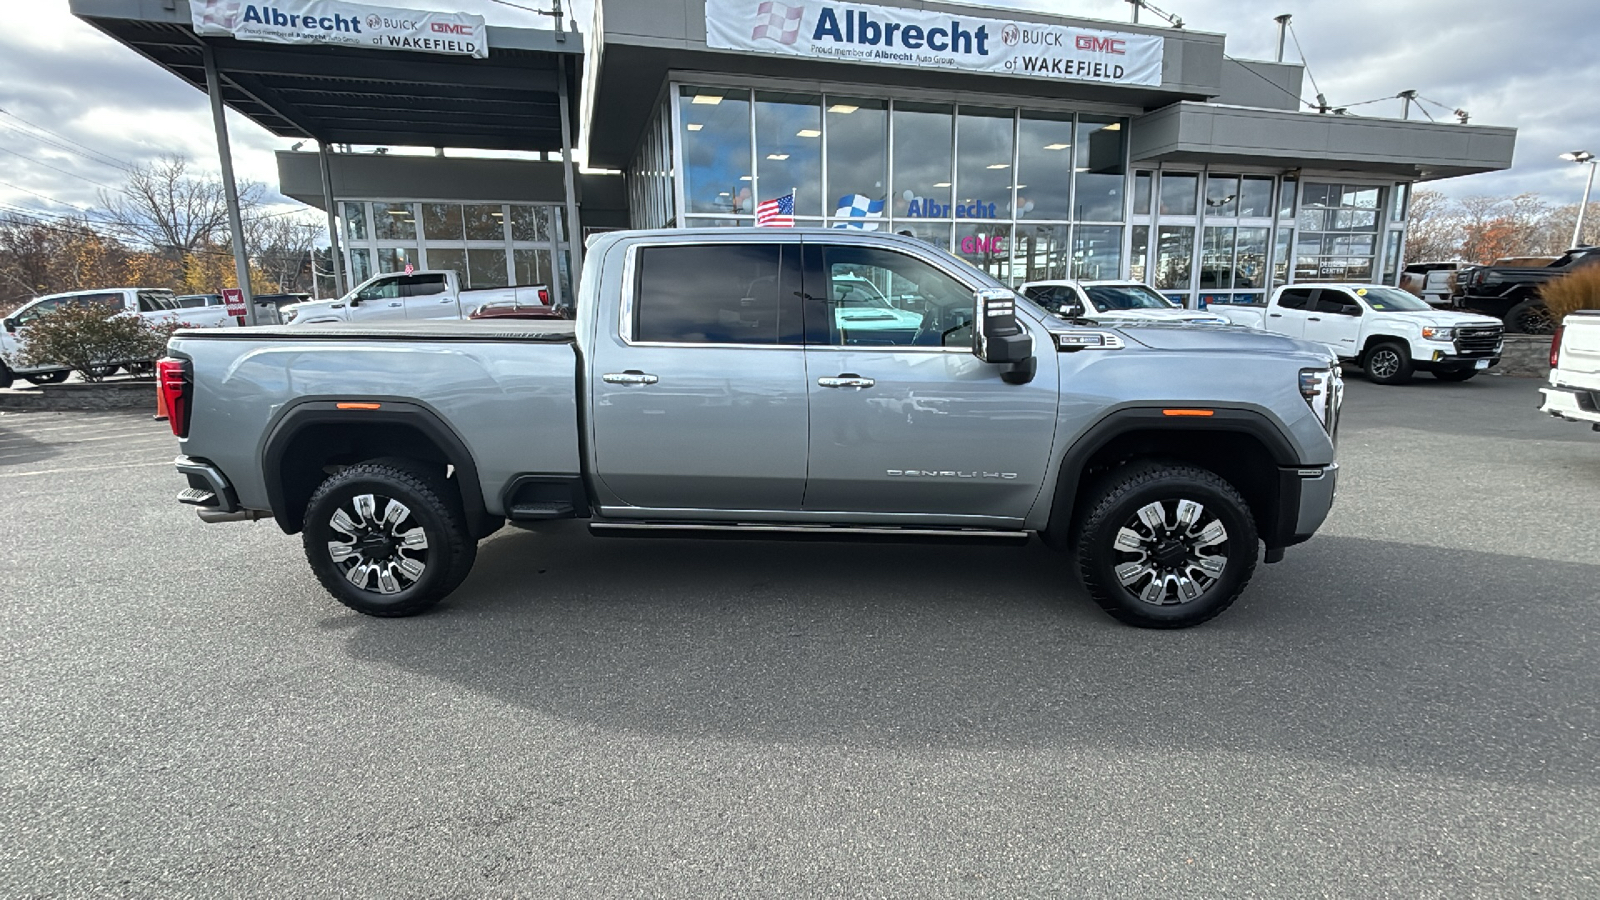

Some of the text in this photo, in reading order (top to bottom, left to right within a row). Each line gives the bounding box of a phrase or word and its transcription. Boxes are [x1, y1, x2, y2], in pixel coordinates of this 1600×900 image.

[243, 4, 362, 33] Albrecht
[384, 18, 418, 30] BUICK
[431, 22, 473, 36] GMC
[812, 7, 989, 55] Albrecht
[1022, 29, 1063, 47] BUICK
[372, 35, 476, 53] of WAKEFIELD
[1075, 34, 1126, 55] GMC
[811, 45, 833, 54] Proud
[834, 48, 864, 57] member
[875, 50, 913, 61] Albrecht
[915, 54, 933, 63] Auto
[933, 55, 955, 65] Group
[1004, 56, 1124, 79] of WAKEFIELD
[907, 198, 996, 218] Albrecht
[961, 236, 1003, 253] GMC
[886, 469, 1018, 479] DENALI HD
